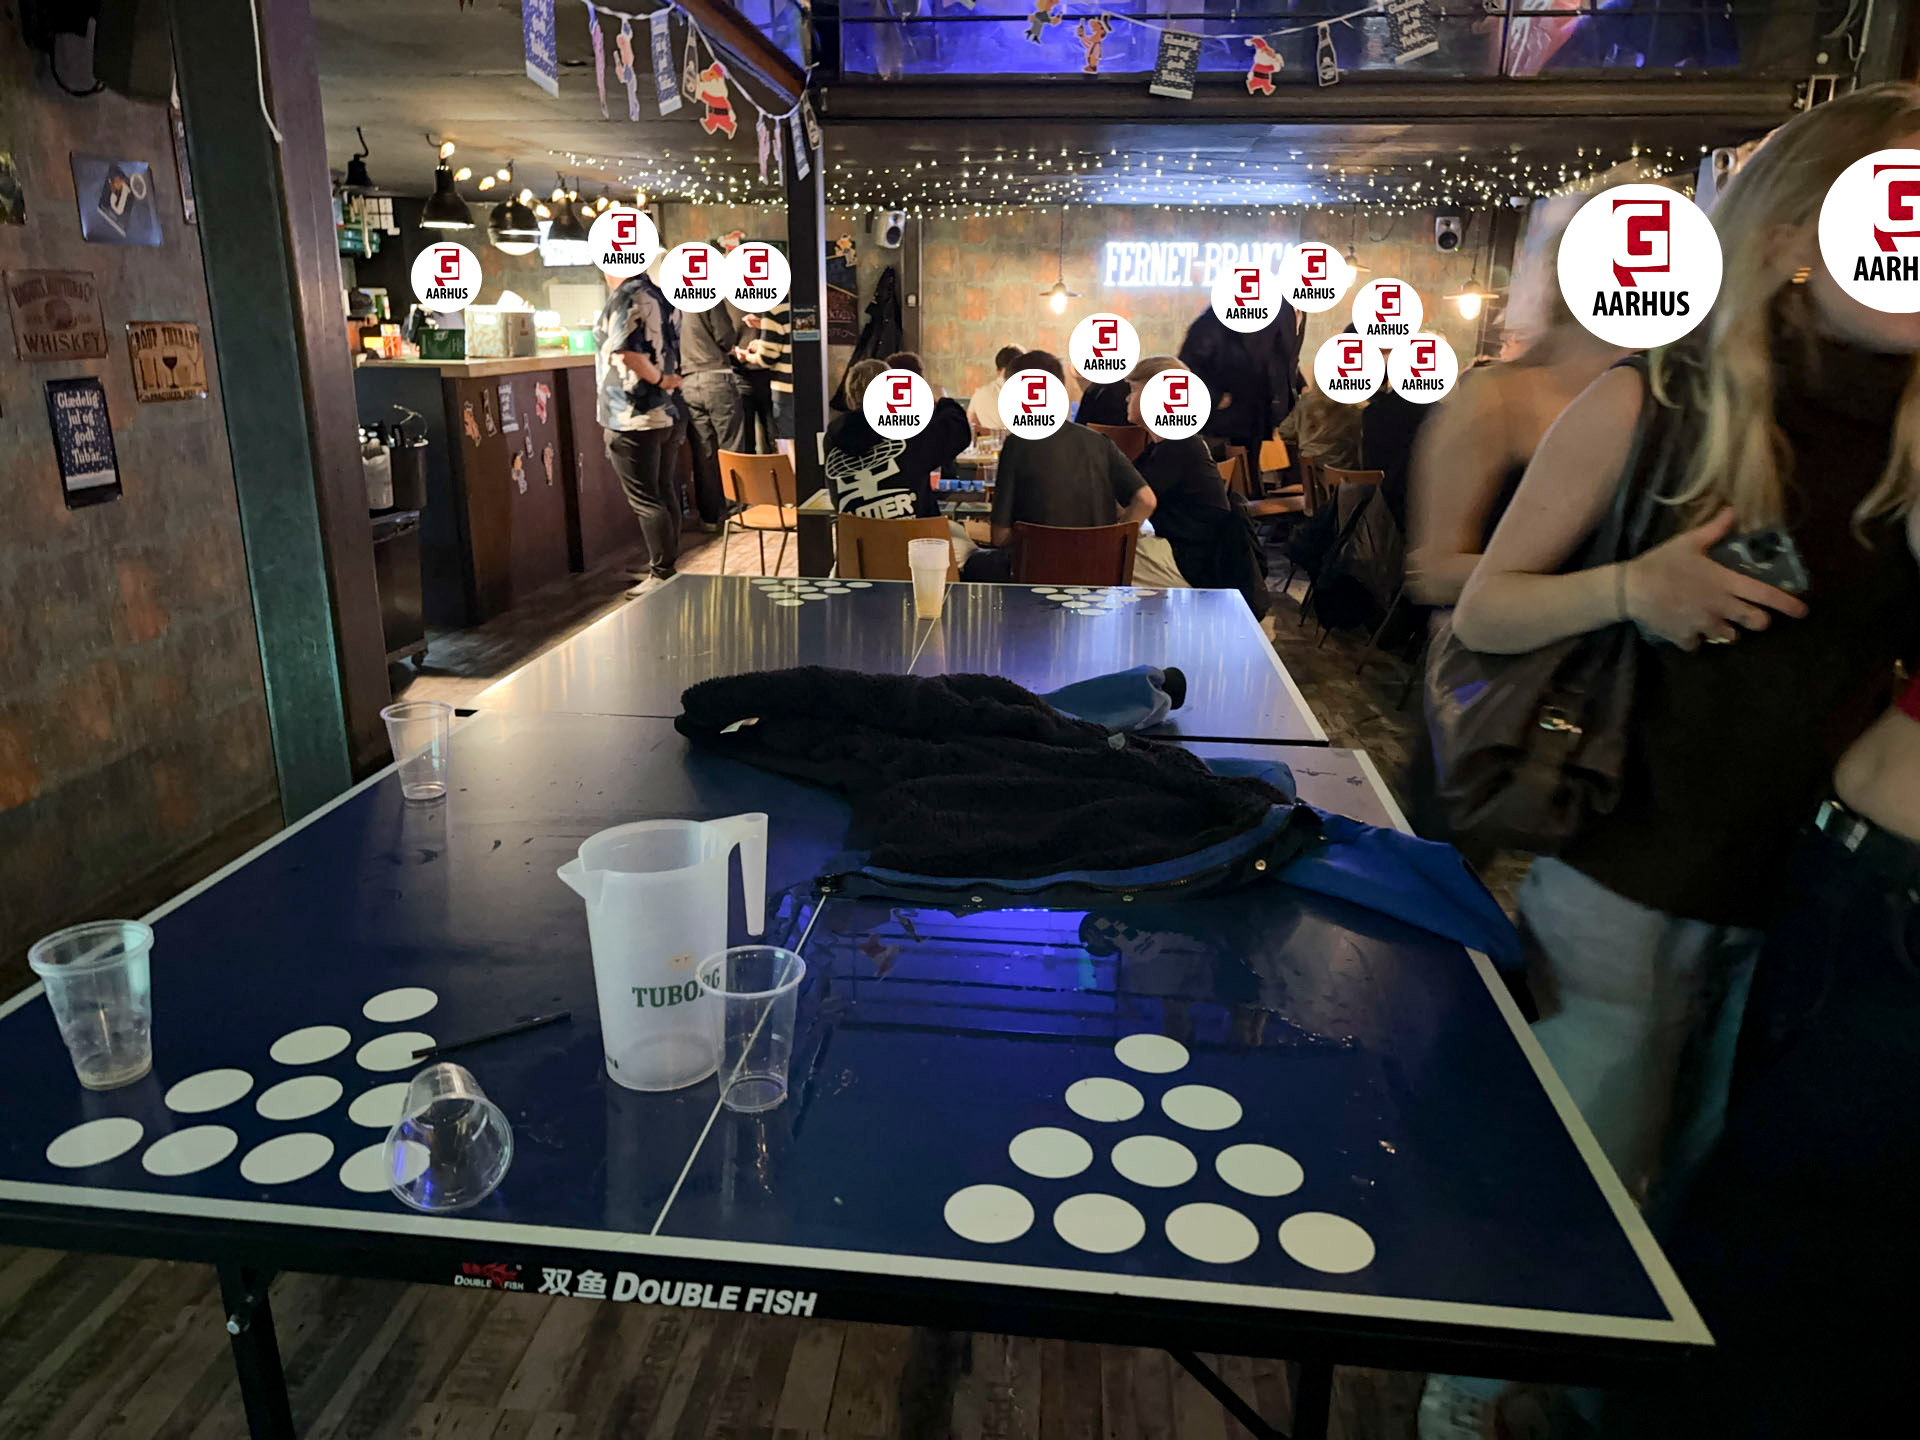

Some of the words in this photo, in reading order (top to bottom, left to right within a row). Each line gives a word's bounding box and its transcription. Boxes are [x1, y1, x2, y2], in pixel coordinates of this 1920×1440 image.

[1103, 241, 1294, 286] FERNET-BRNC
[23, 332, 101, 353] WHISKEY
[82, 408, 95, 427] og
[74, 426, 95, 447] godt
[454, 1274, 492, 1289] DOUBLE
[504, 1280, 524, 1291] FISH
[539, 1267, 606, 1300] 双鱼
[612, 1271, 741, 1311] DOUBLE
[745, 1287, 818, 1317] FISH
